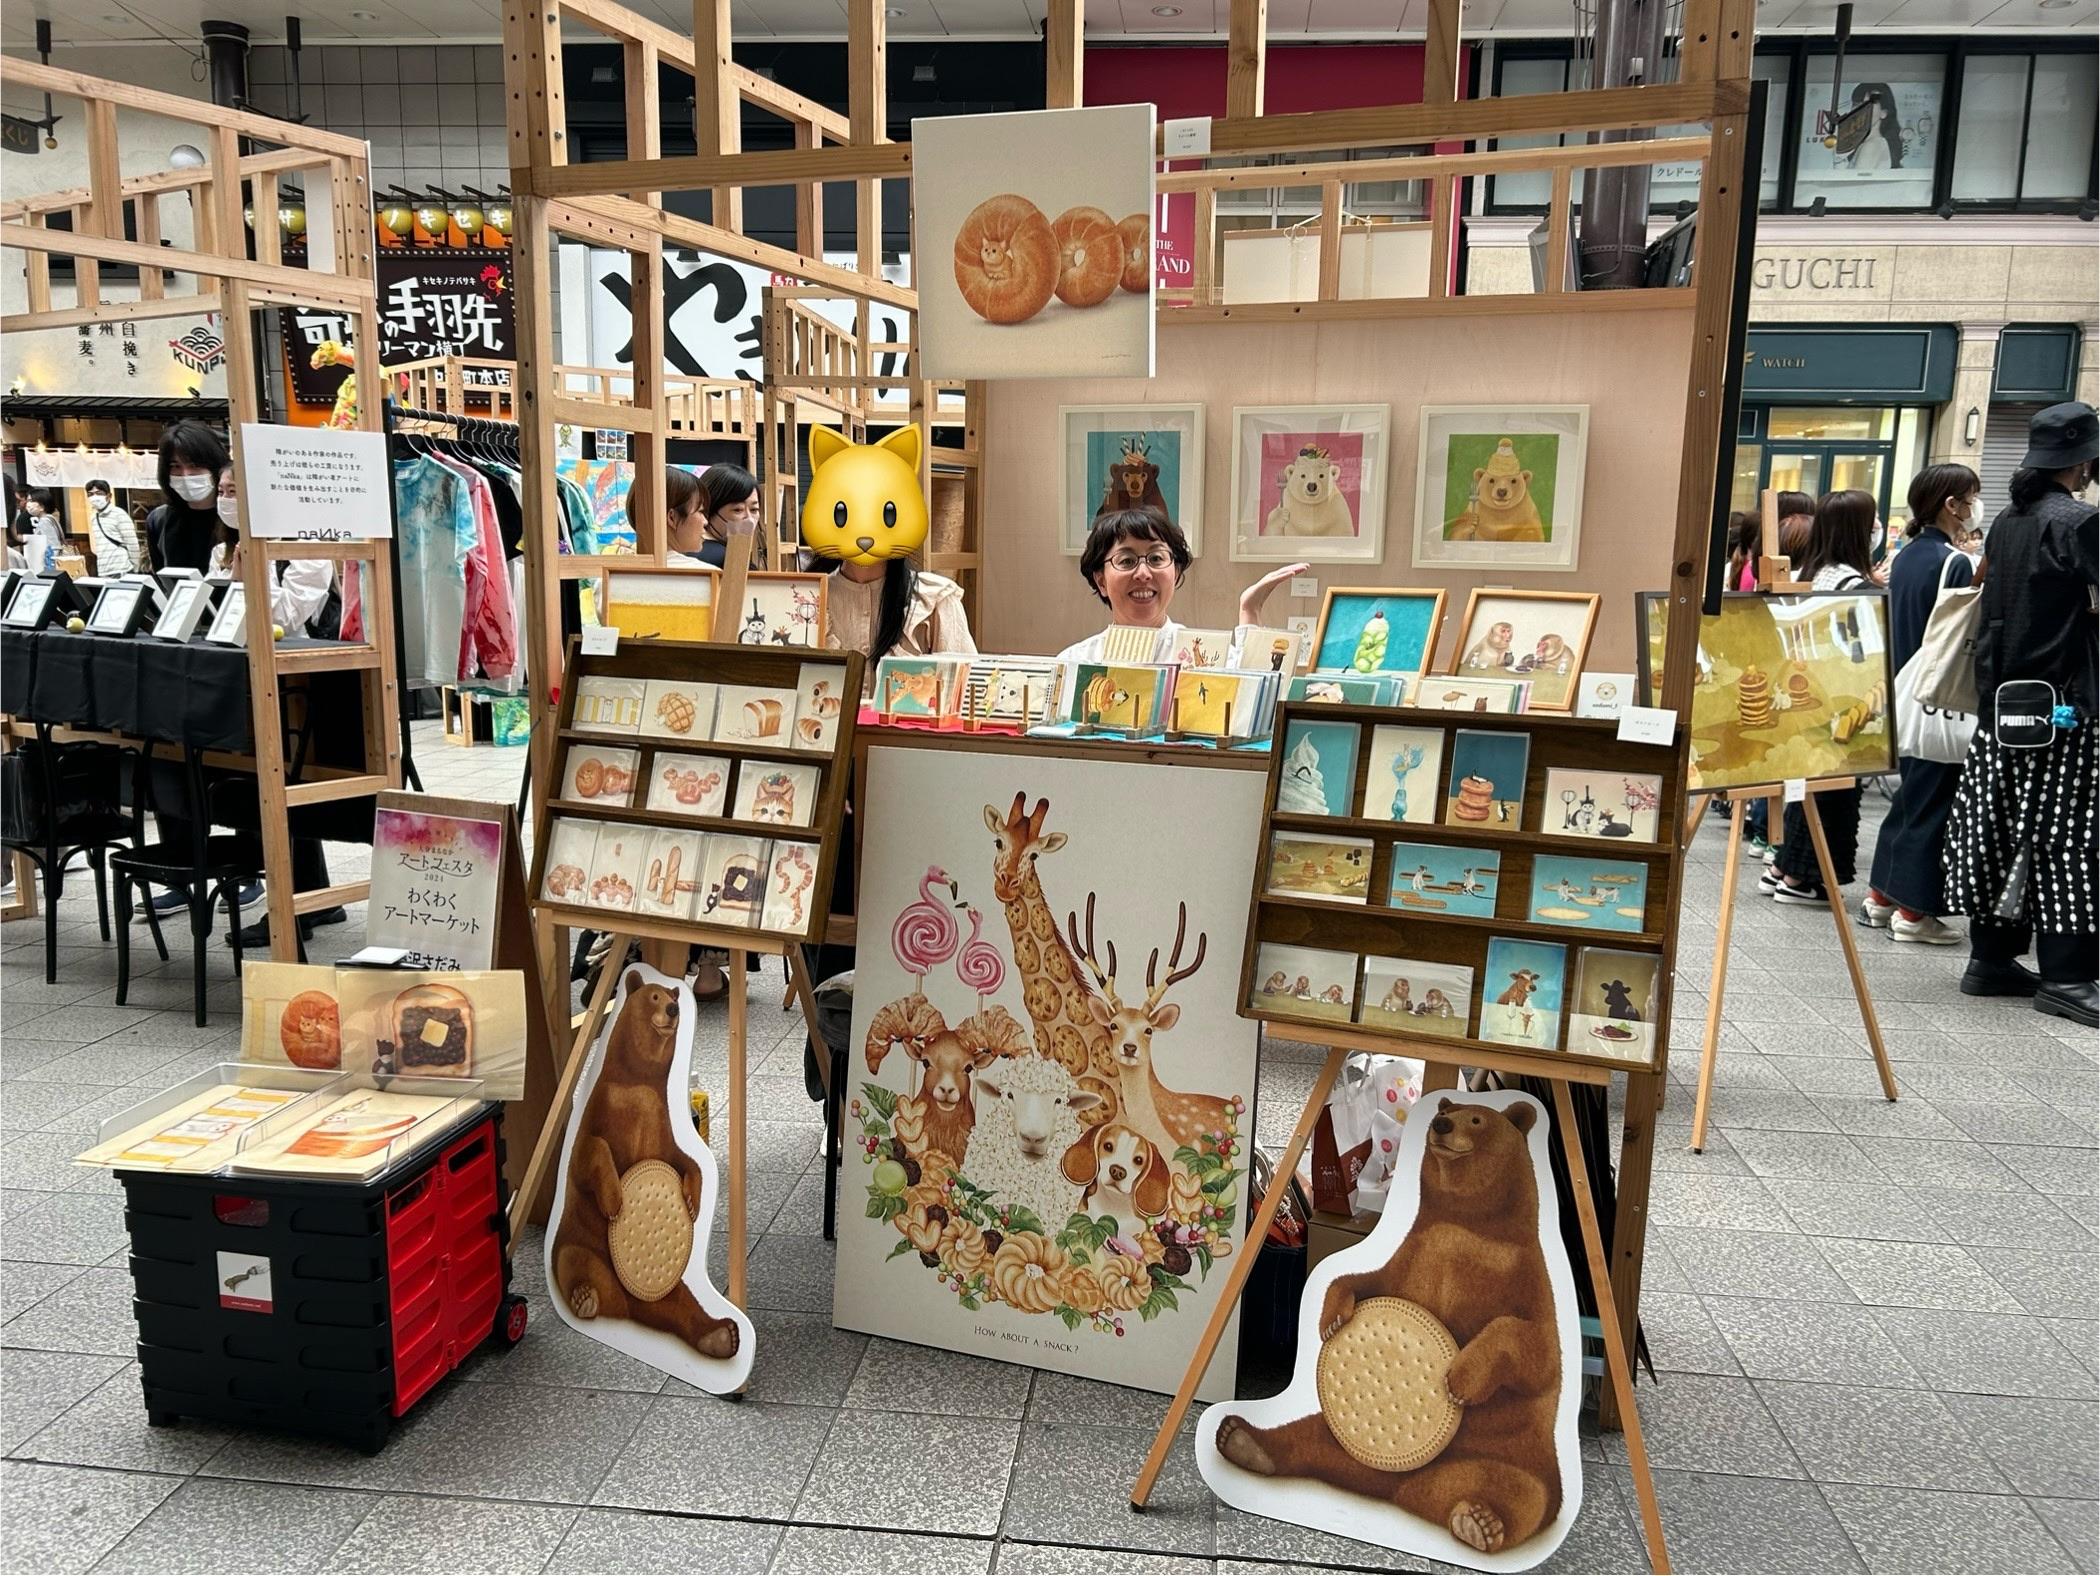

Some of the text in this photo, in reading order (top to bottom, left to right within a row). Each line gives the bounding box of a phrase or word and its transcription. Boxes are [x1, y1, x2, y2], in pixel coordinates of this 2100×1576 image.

[422, 276, 476, 286] キセキノテバサキ
[1762, 357, 1806, 369] WATCH
[2000, 715, 2036, 727] PUMA
[398, 852, 474, 877] アートフェスタ
[424, 873, 445, 883] 2024
[408, 888, 457, 910] わくわく
[384, 905, 480, 935] アートマーケット
[402, 950, 461, 971] 沢さだみ
